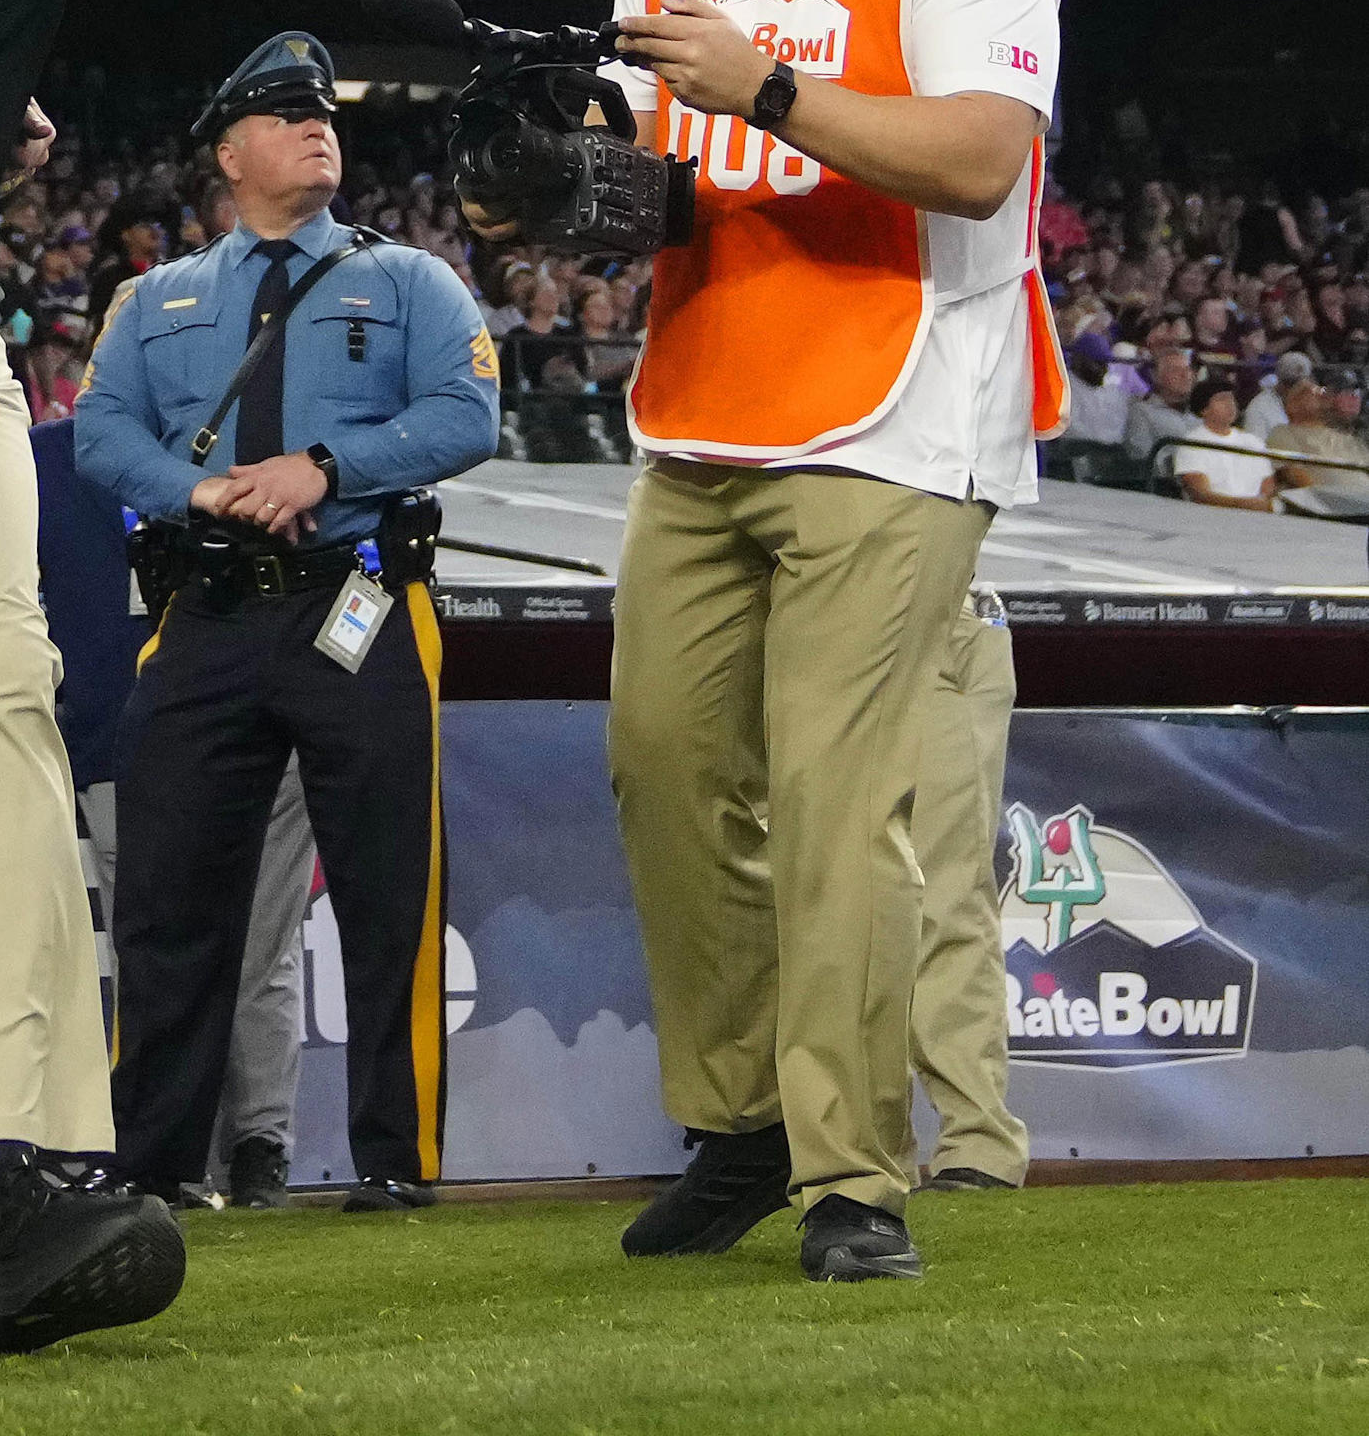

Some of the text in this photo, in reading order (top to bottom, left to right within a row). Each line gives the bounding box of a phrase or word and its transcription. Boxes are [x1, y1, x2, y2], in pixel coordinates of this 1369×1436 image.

[750, 22, 836, 63] Bowl
[444, 597, 502, 617] Health
[1103, 602, 1209, 621] Banner Health
